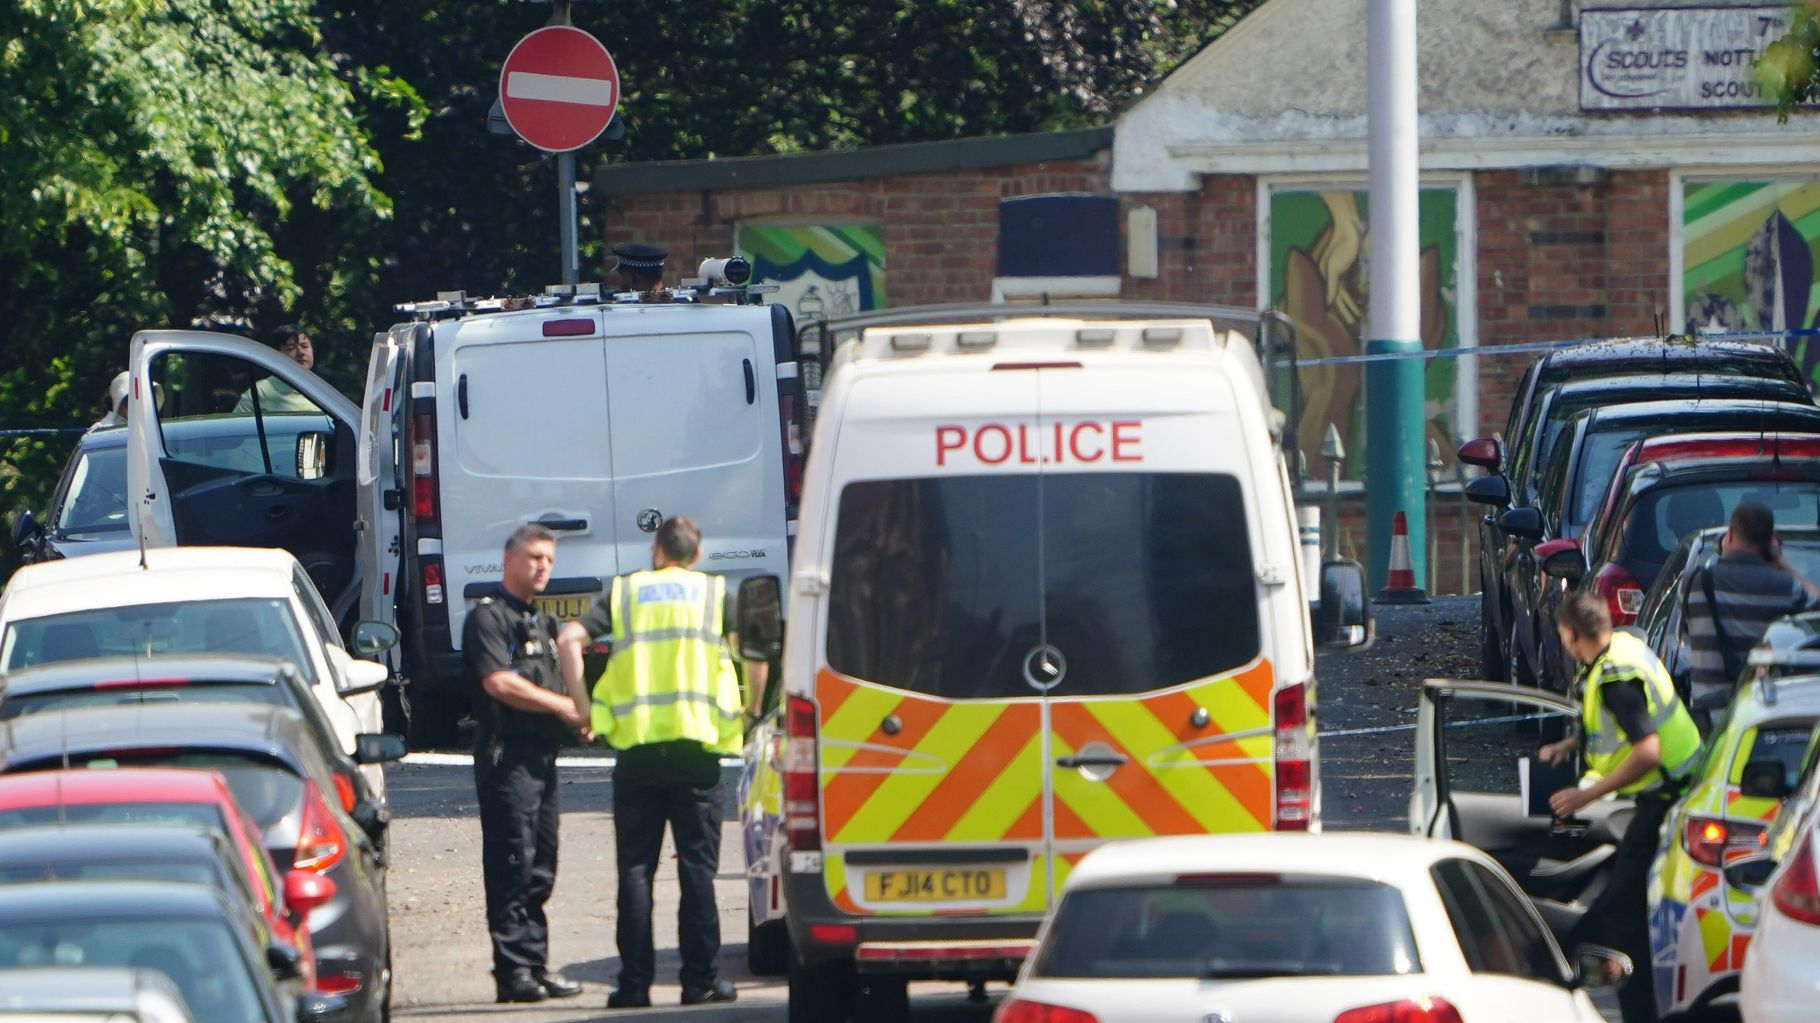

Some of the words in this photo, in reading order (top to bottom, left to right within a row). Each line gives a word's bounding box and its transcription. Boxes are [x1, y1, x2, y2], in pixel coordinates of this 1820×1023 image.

[1703, 48, 1756, 66] NOTT
[935, 419, 1144, 467] POLICE
[463, 563, 505, 575] VIVA
[880, 871, 934, 897] FJ14
